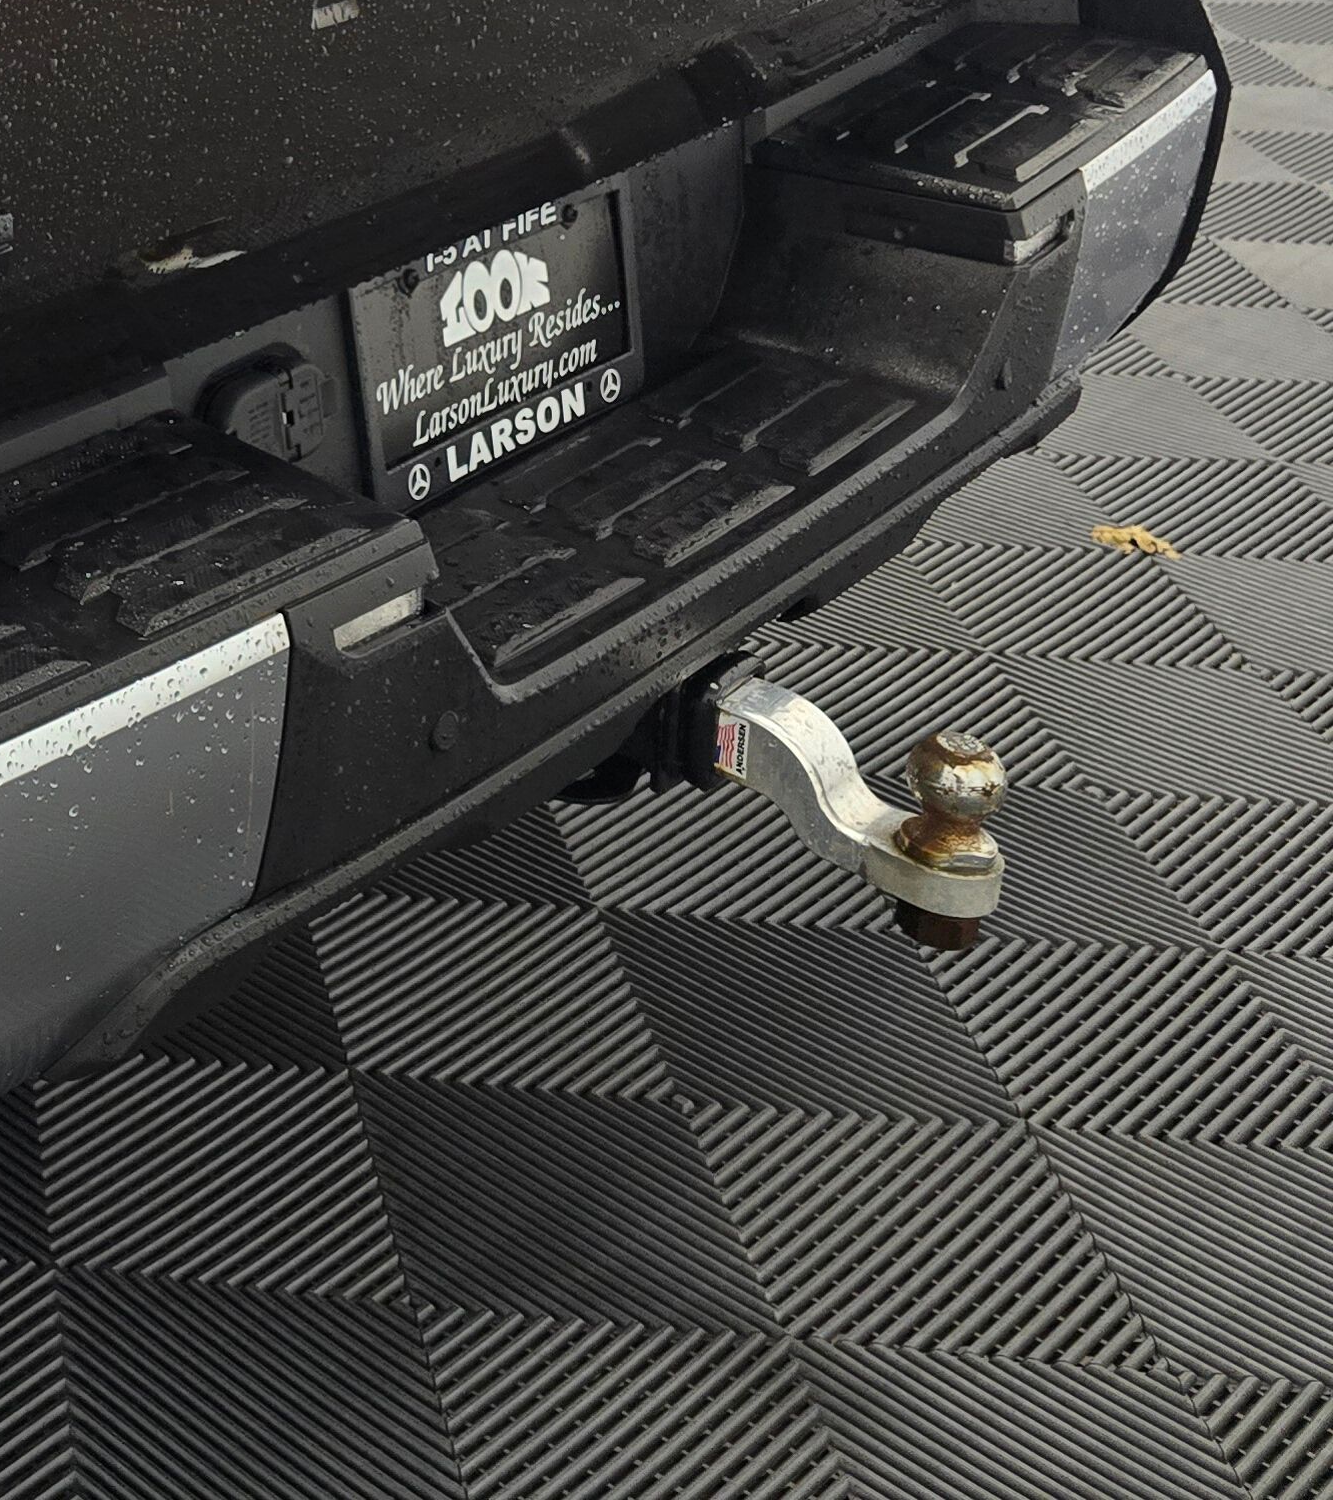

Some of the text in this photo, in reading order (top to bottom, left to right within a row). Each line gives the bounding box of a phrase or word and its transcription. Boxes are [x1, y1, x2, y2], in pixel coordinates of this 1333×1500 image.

[377, 365, 444, 414] Where
[450, 329, 522, 382] Luxury
[529, 288, 620, 347] Resides...
[414, 339, 597, 446] LarsonLuxury.com
[447, 383, 586, 482] LARSON
[736, 723, 747, 775] ANDERSEN
